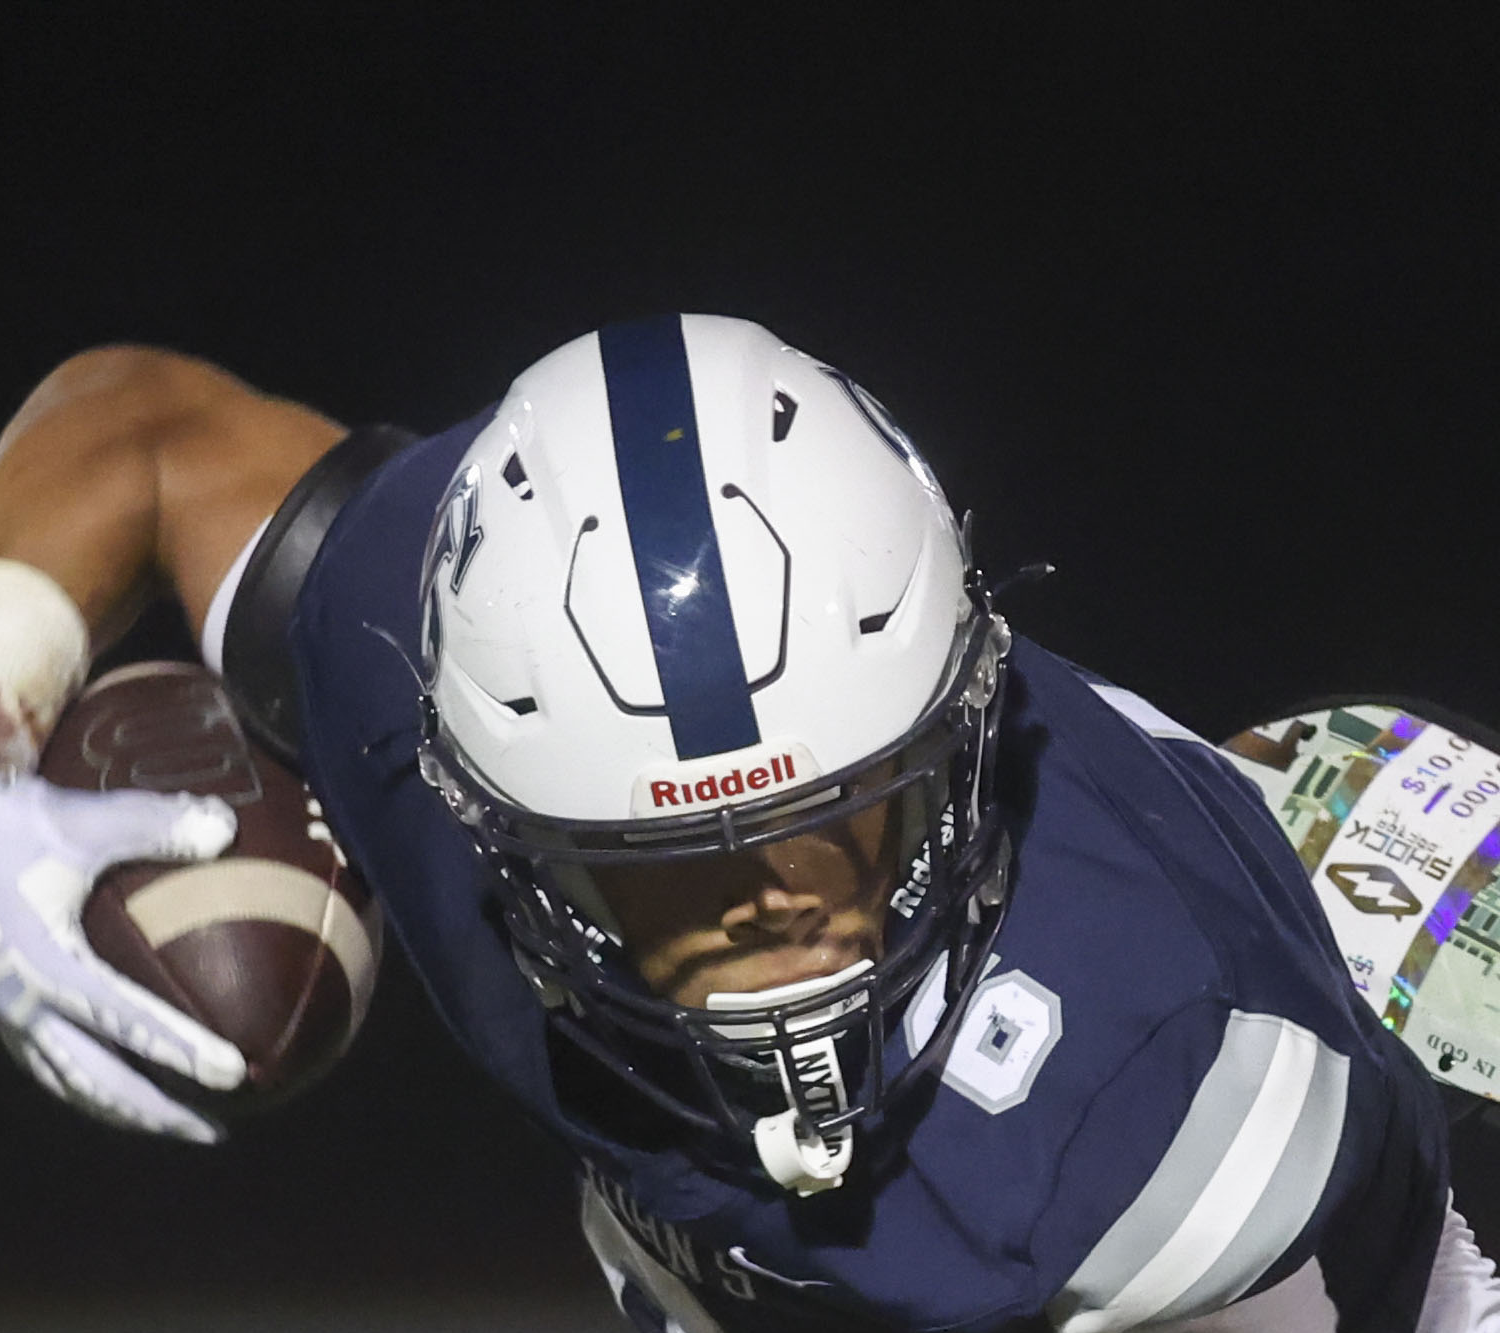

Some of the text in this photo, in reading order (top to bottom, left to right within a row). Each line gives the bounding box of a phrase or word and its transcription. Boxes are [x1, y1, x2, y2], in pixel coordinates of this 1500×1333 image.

[650, 753, 797, 809] Riddell
[1346, 819, 1453, 881] SHOCK
[1428, 1034, 1497, 1079] IN GOD
